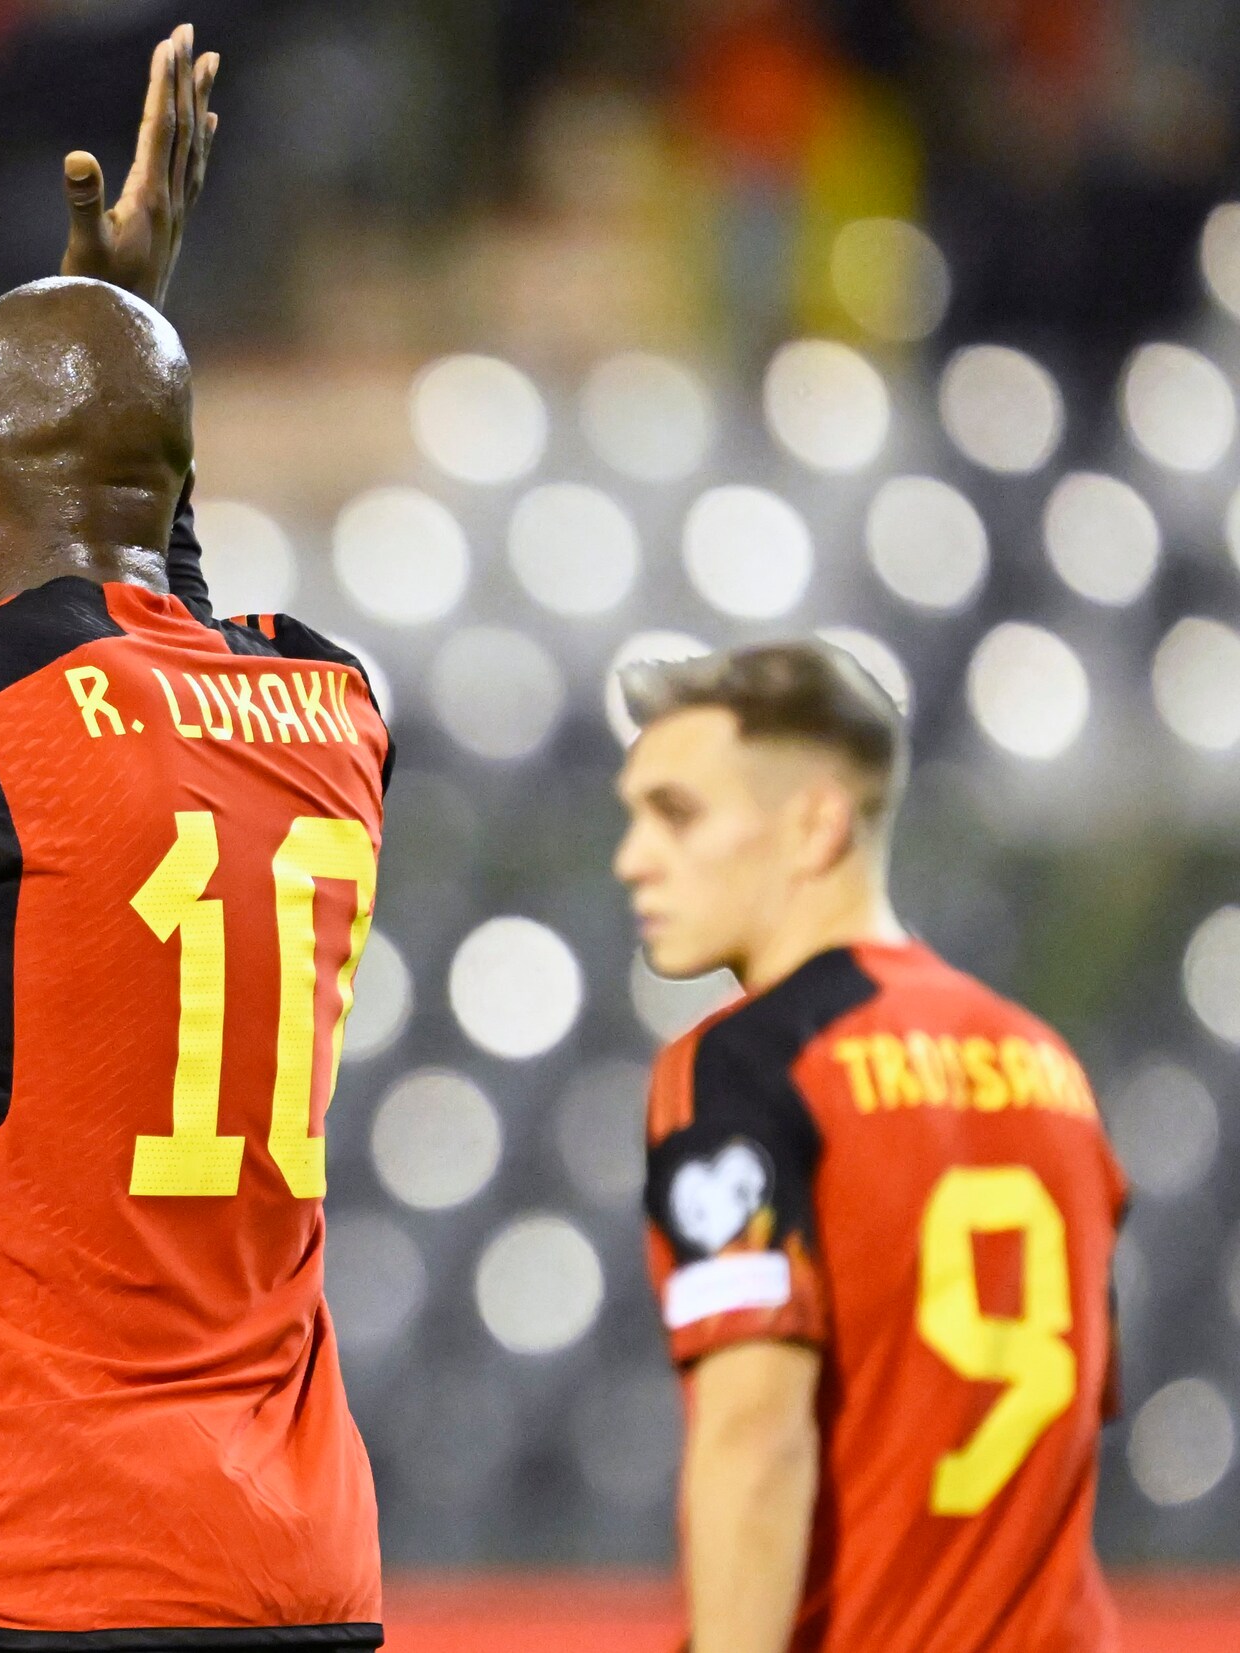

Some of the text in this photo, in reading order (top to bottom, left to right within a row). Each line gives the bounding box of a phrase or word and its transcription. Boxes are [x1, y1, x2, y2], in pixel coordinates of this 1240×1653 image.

[64, 665, 359, 745] R. LUKAKU
[128, 811, 377, 1199] 10
[917, 1163, 1078, 1516] 9
